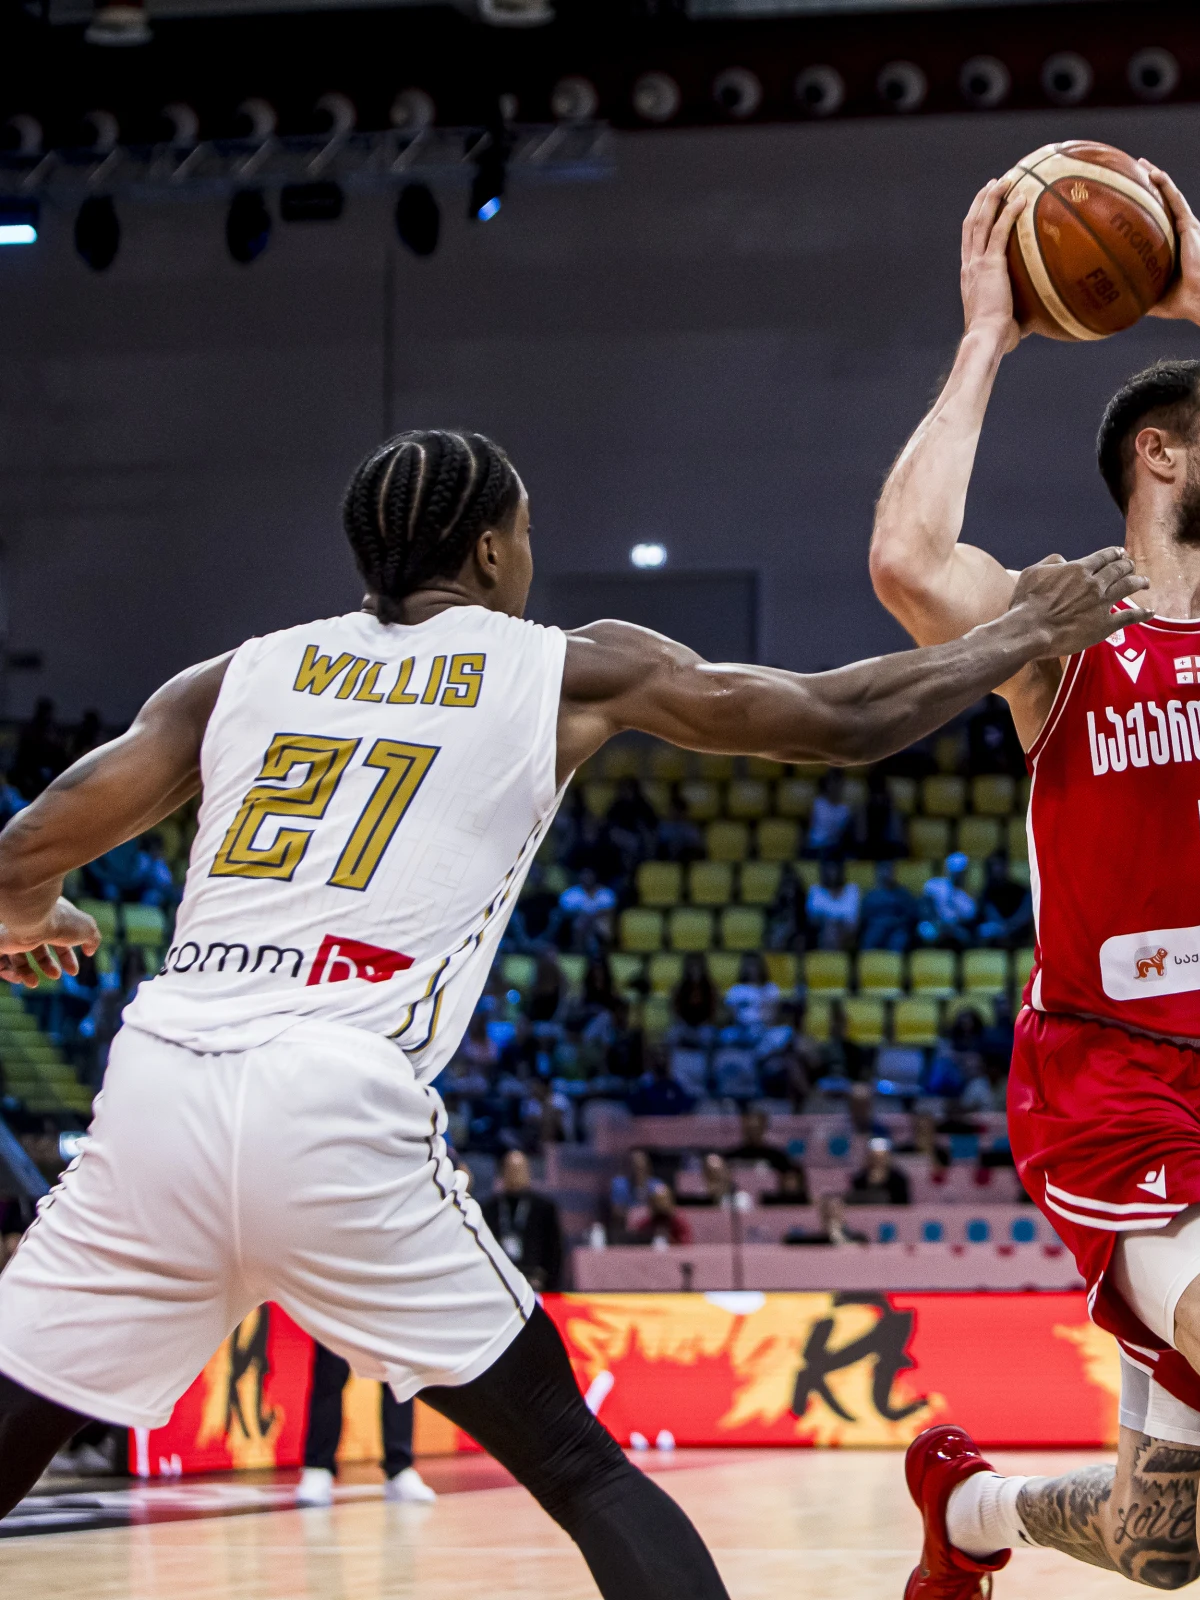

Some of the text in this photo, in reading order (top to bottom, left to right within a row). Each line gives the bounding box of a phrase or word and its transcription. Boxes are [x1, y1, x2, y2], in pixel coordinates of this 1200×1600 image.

[1109, 212, 1163, 283] molten
[293, 644, 487, 708] WILLIS
[207, 732, 442, 892] 21
